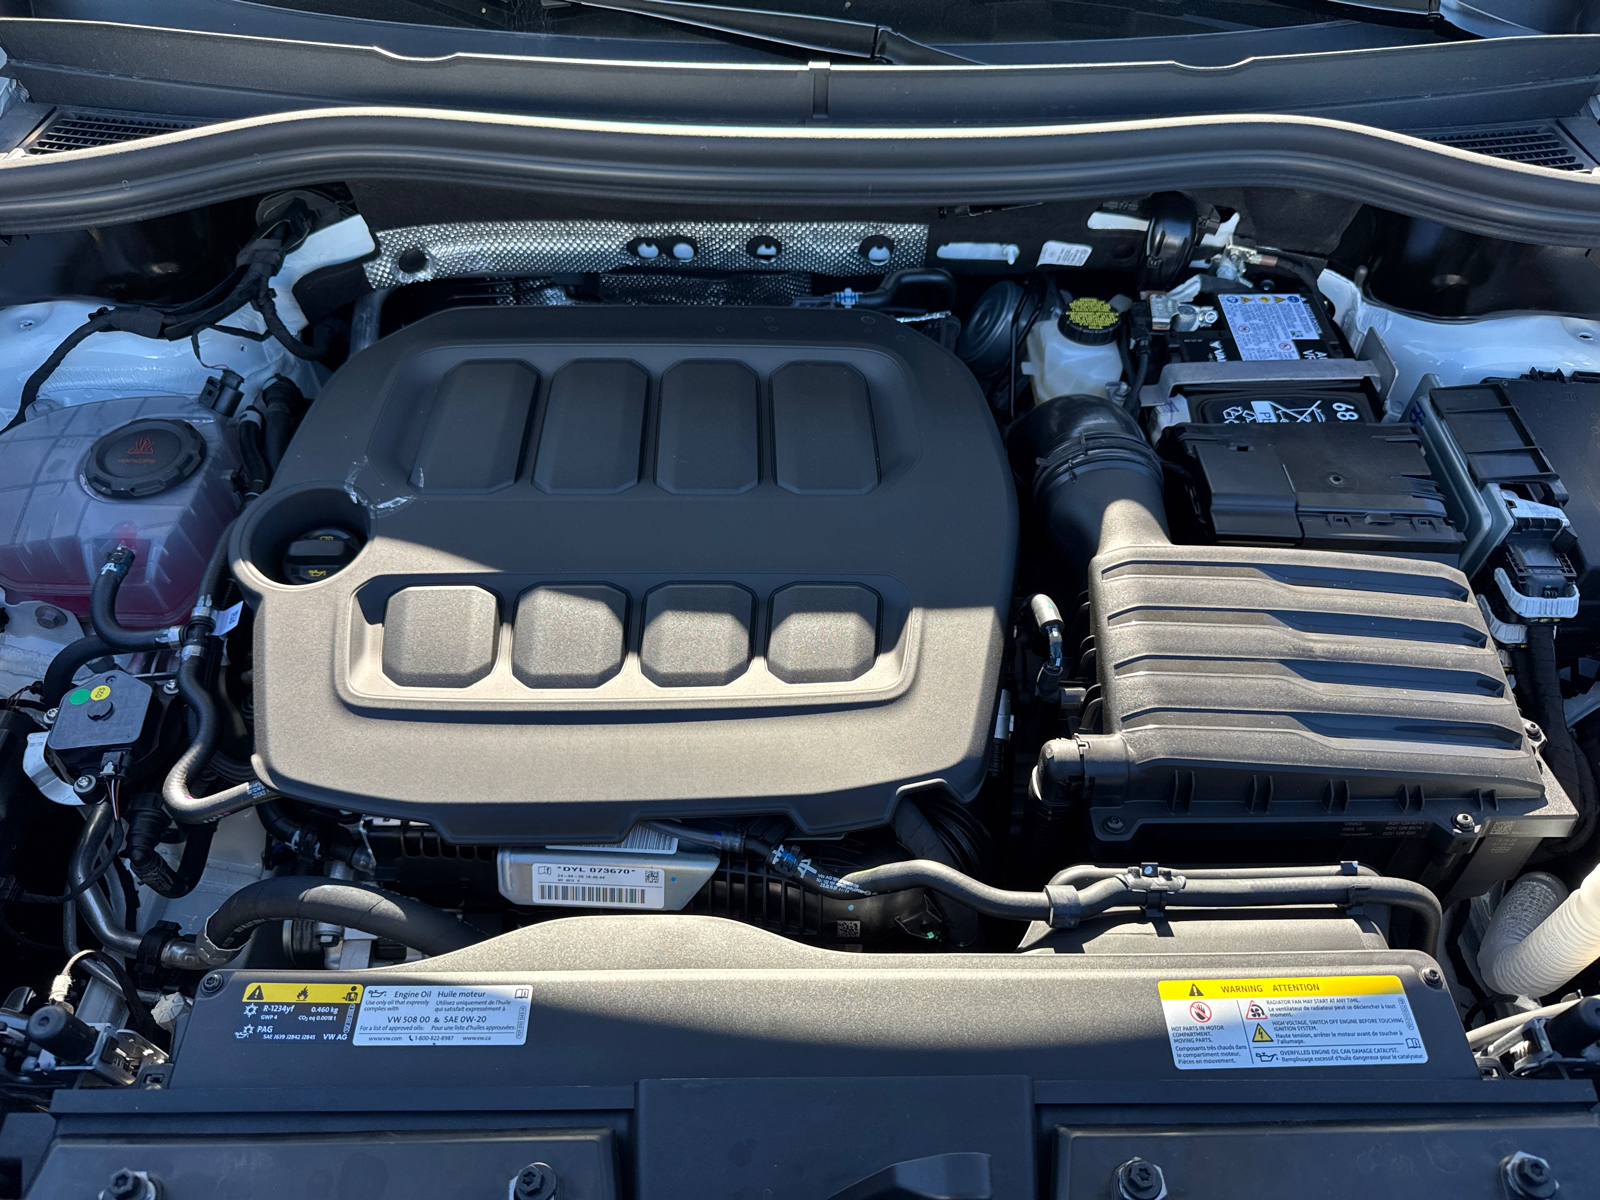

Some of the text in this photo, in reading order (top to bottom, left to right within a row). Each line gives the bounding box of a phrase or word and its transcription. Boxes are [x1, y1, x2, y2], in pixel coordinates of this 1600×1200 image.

[1220, 984, 1320, 993] WARNING ATTENTION
[394, 991, 419, 999] Engine
[262, 1005, 295, 1013] R-1234yf
[256, 1025, 274, 1033] PAG
